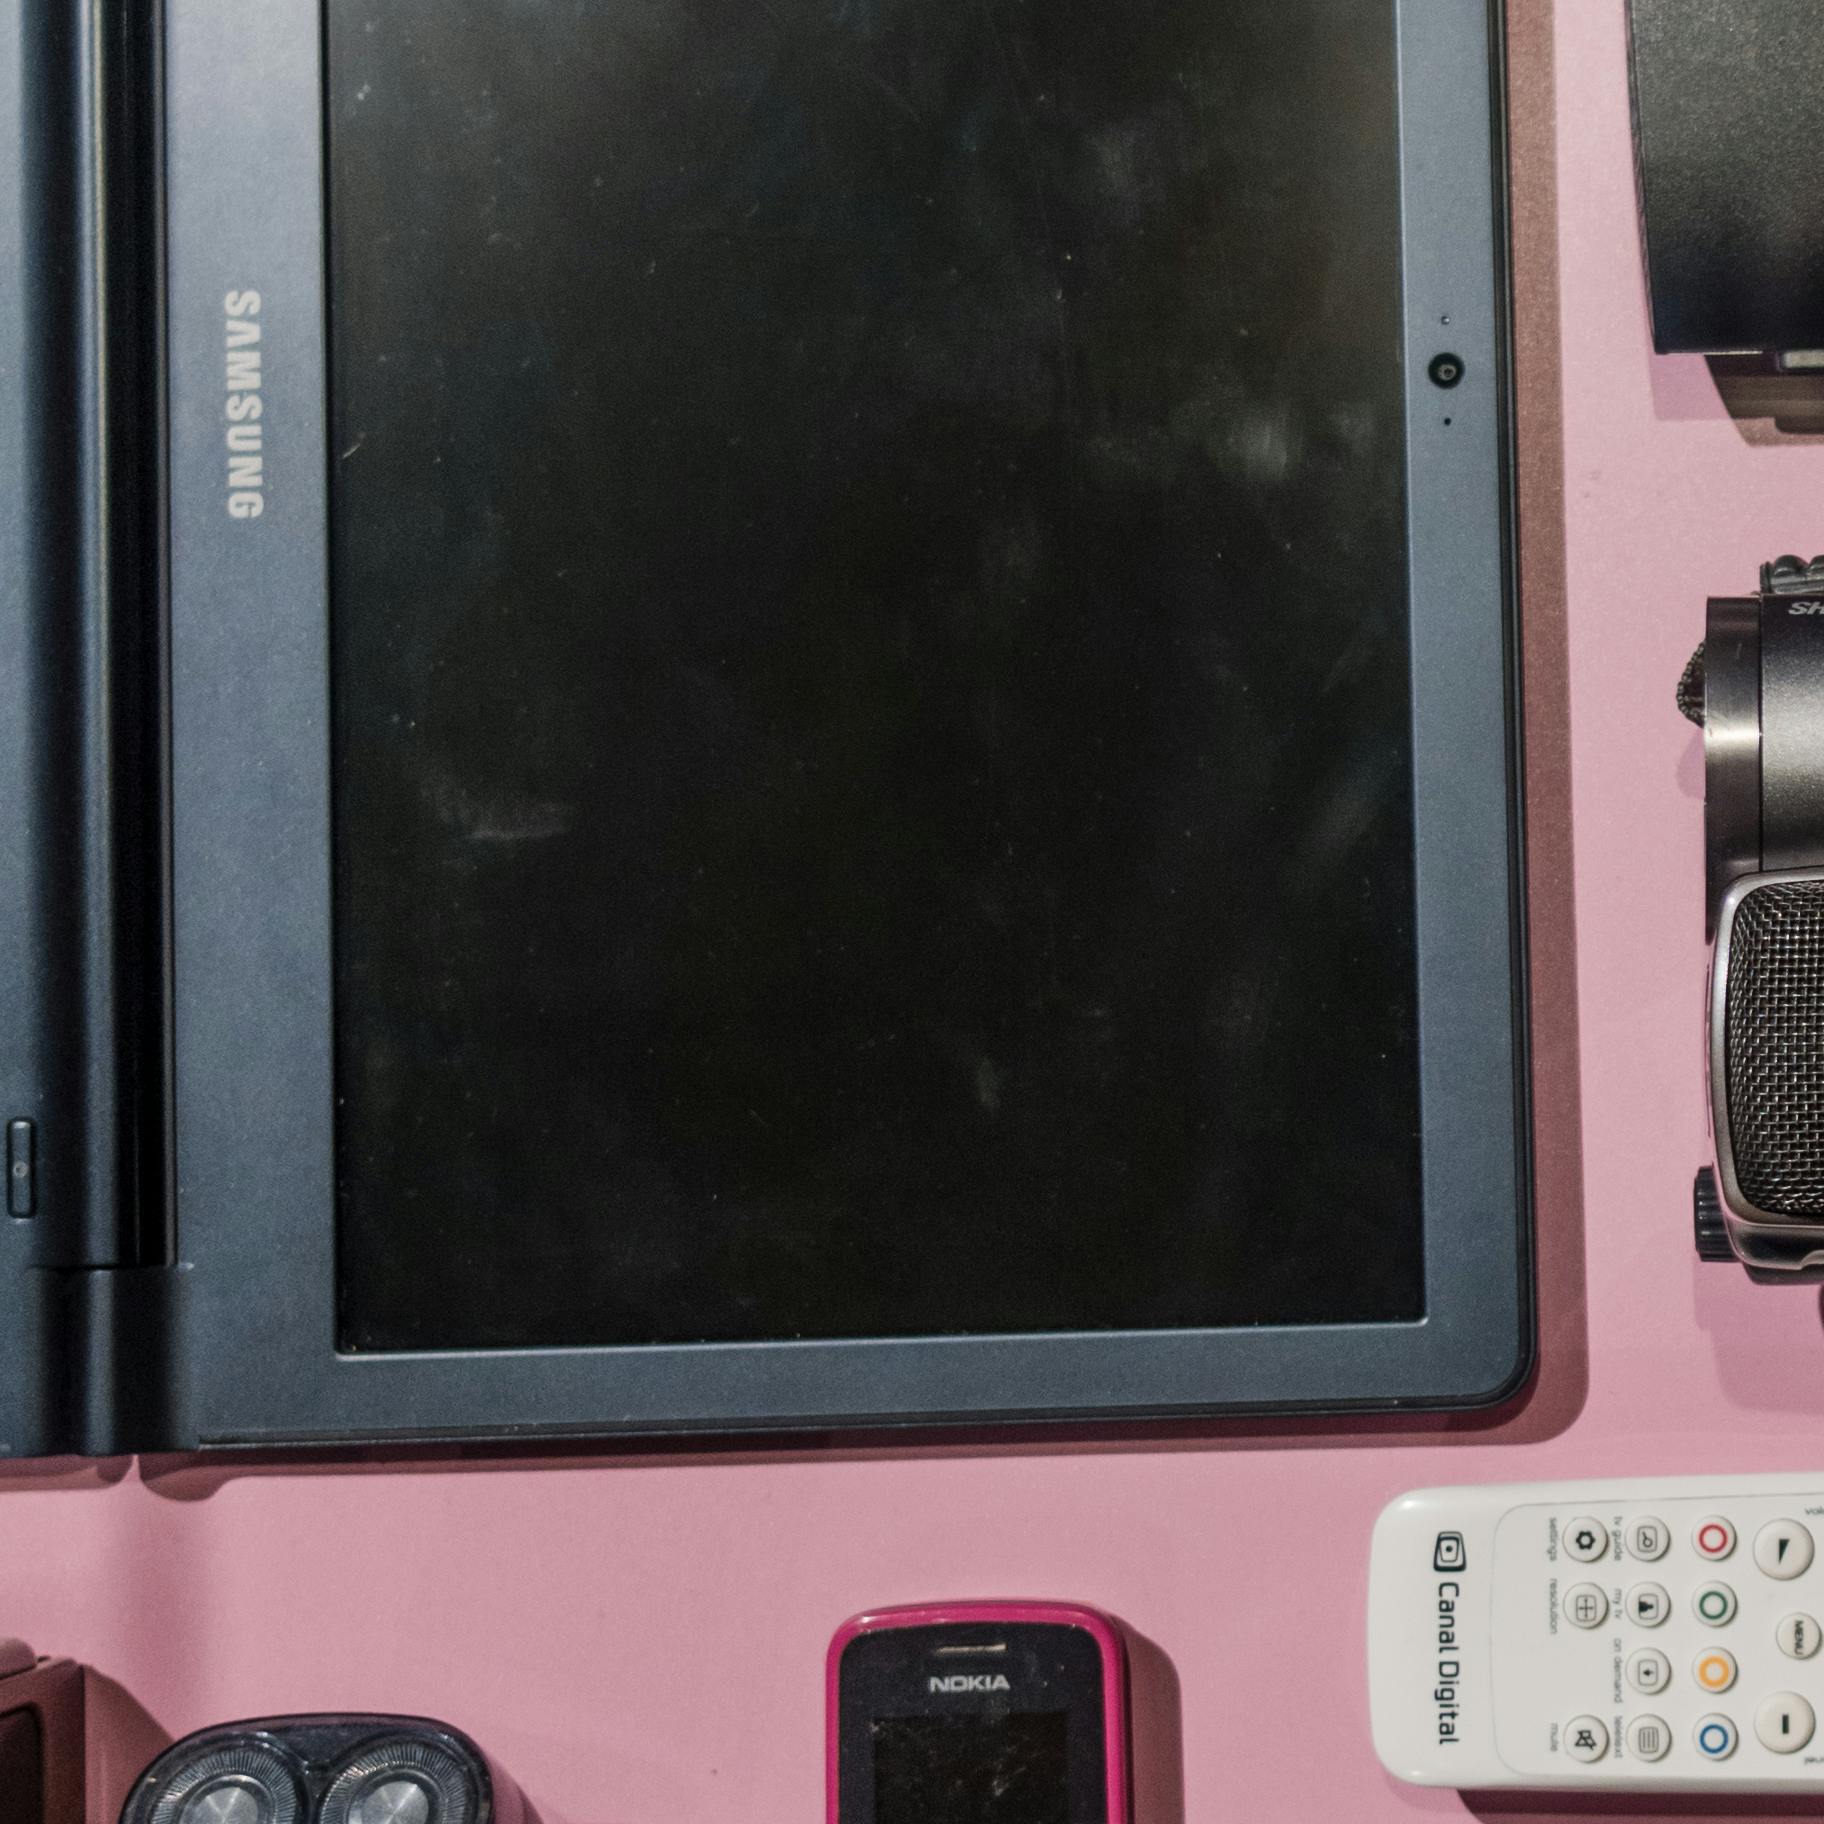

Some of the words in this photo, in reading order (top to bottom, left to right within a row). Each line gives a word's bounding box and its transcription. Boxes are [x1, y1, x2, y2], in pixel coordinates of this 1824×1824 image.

[224, 289, 264, 519] SAMSUNG
[1547, 1516, 1560, 1562] settings
[1611, 1529, 1624, 1562] guide
[1438, 1581, 1461, 1655] Canal
[1549, 1578, 1560, 1635] resolution
[1611, 1588, 1623, 1606] my
[1613, 1638, 1622, 1653] on
[1795, 1620, 1806, 1656] MENU
[928, 1673, 1012, 1694] NOKIA
[1613, 1655, 1624, 1704] demand
[1434, 1660, 1461, 1746] Digital
[1549, 1722, 1559, 1753] mute
[1613, 1715, 1623, 1759] teletext
